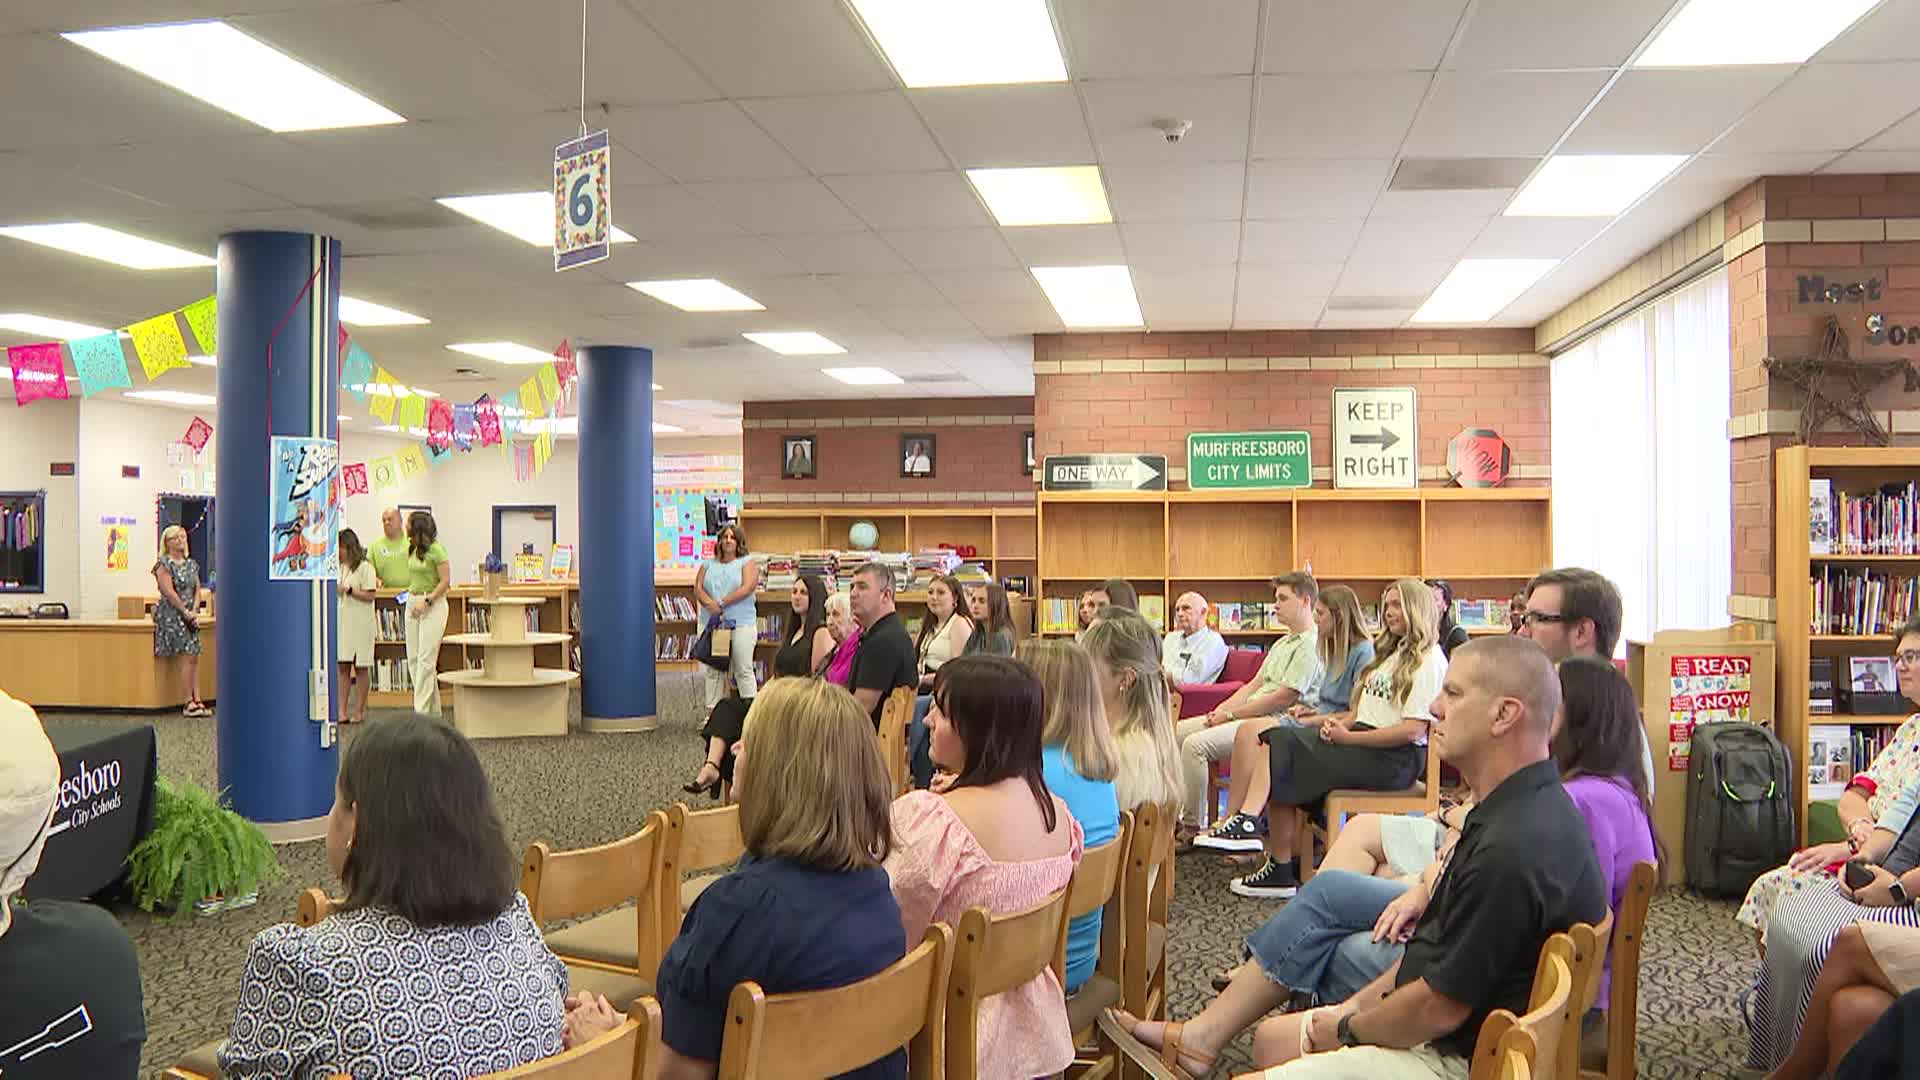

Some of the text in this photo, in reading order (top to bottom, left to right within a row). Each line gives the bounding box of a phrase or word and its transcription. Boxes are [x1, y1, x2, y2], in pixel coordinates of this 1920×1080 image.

[569, 173, 594, 226] 6
[1347, 401, 1404, 421] KEEP
[1193, 439, 1306, 457] MURFREESBORO
[1057, 465, 1128, 481] ONE WAY
[1207, 463, 1292, 481] CITY LIMITS
[1344, 456, 1409, 477] RIGHT
[1693, 658, 1750, 675] READ
[72, 792, 121, 829] City Schools
